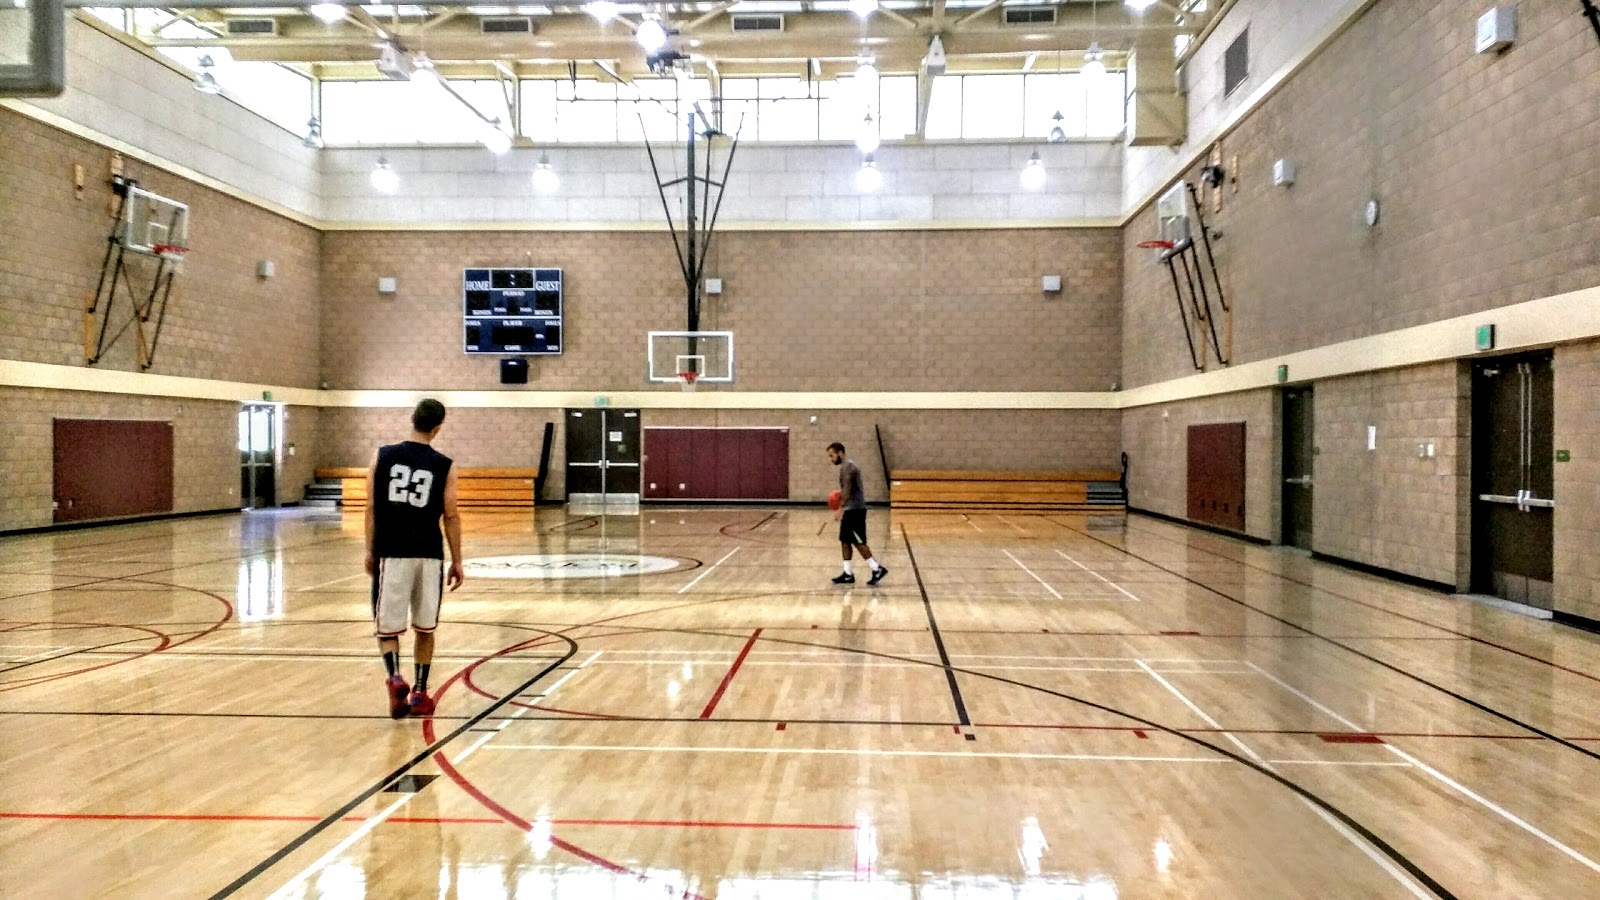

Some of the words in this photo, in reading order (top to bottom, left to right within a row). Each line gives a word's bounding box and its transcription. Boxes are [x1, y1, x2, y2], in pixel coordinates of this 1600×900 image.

[466, 280, 490, 291] HOME
[535, 280, 560, 291] GUEST
[388, 463, 434, 508] 23
